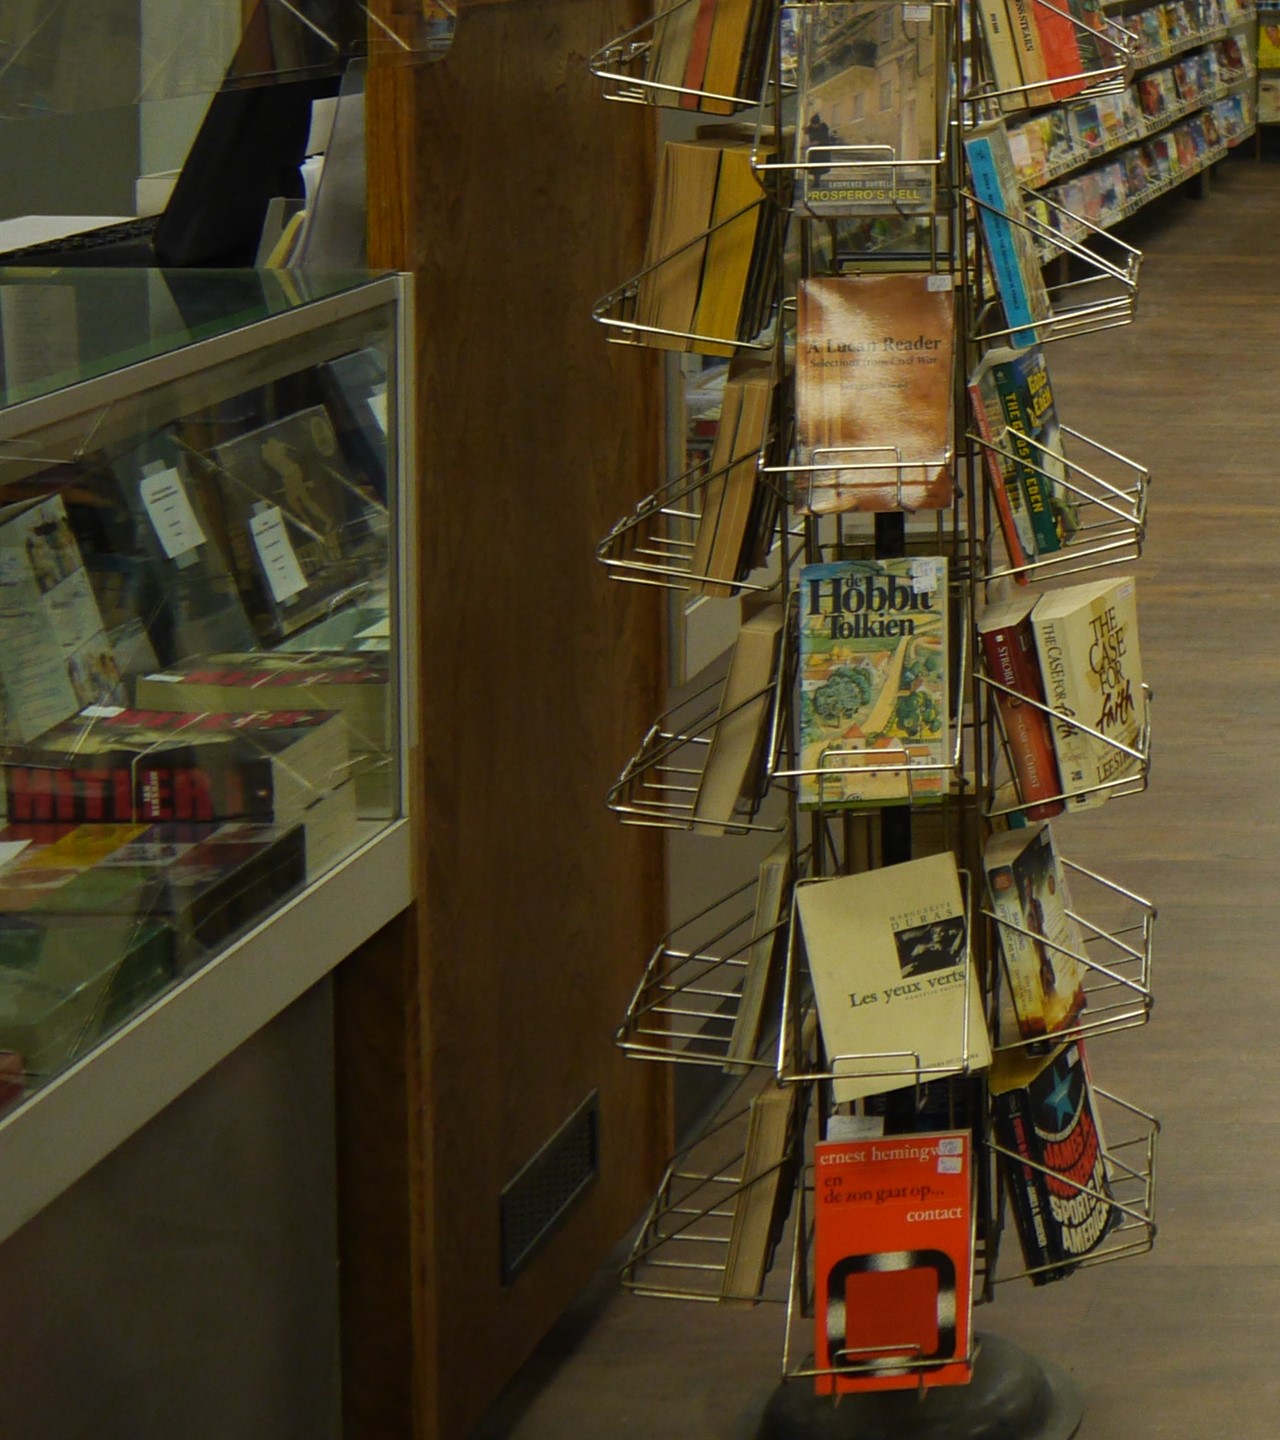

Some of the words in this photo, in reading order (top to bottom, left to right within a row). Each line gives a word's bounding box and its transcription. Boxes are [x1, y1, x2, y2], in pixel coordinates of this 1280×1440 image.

[883, 335, 942, 353] Reader
[917, 355, 938, 365] War
[1005, 392, 1021, 422] THE
[1025, 477, 1045, 513] EDEN
[845, 573, 862, 589] de
[823, 612, 915, 640] Tolkien
[1087, 605, 1119, 642] THE
[1089, 625, 1127, 676] CASE
[999, 645, 1017, 687] STROBEL
[1099, 660, 1125, 696] FOR
[8, 765, 214, 821] HITLER
[891, 910, 954, 932] DURAS
[848, 992, 878, 1009] Les
[883, 980, 921, 1005] yeux
[926, 967, 966, 990] verts
[819, 1147, 867, 1166] ernest
[871, 1143, 942, 1162] hemingw
[823, 1176, 843, 1188] en
[823, 1188, 842, 1204] de
[845, 1189, 874, 1202] zon
[875, 1185, 908, 1206] gaat
[906, 1206, 963, 1223] contact
